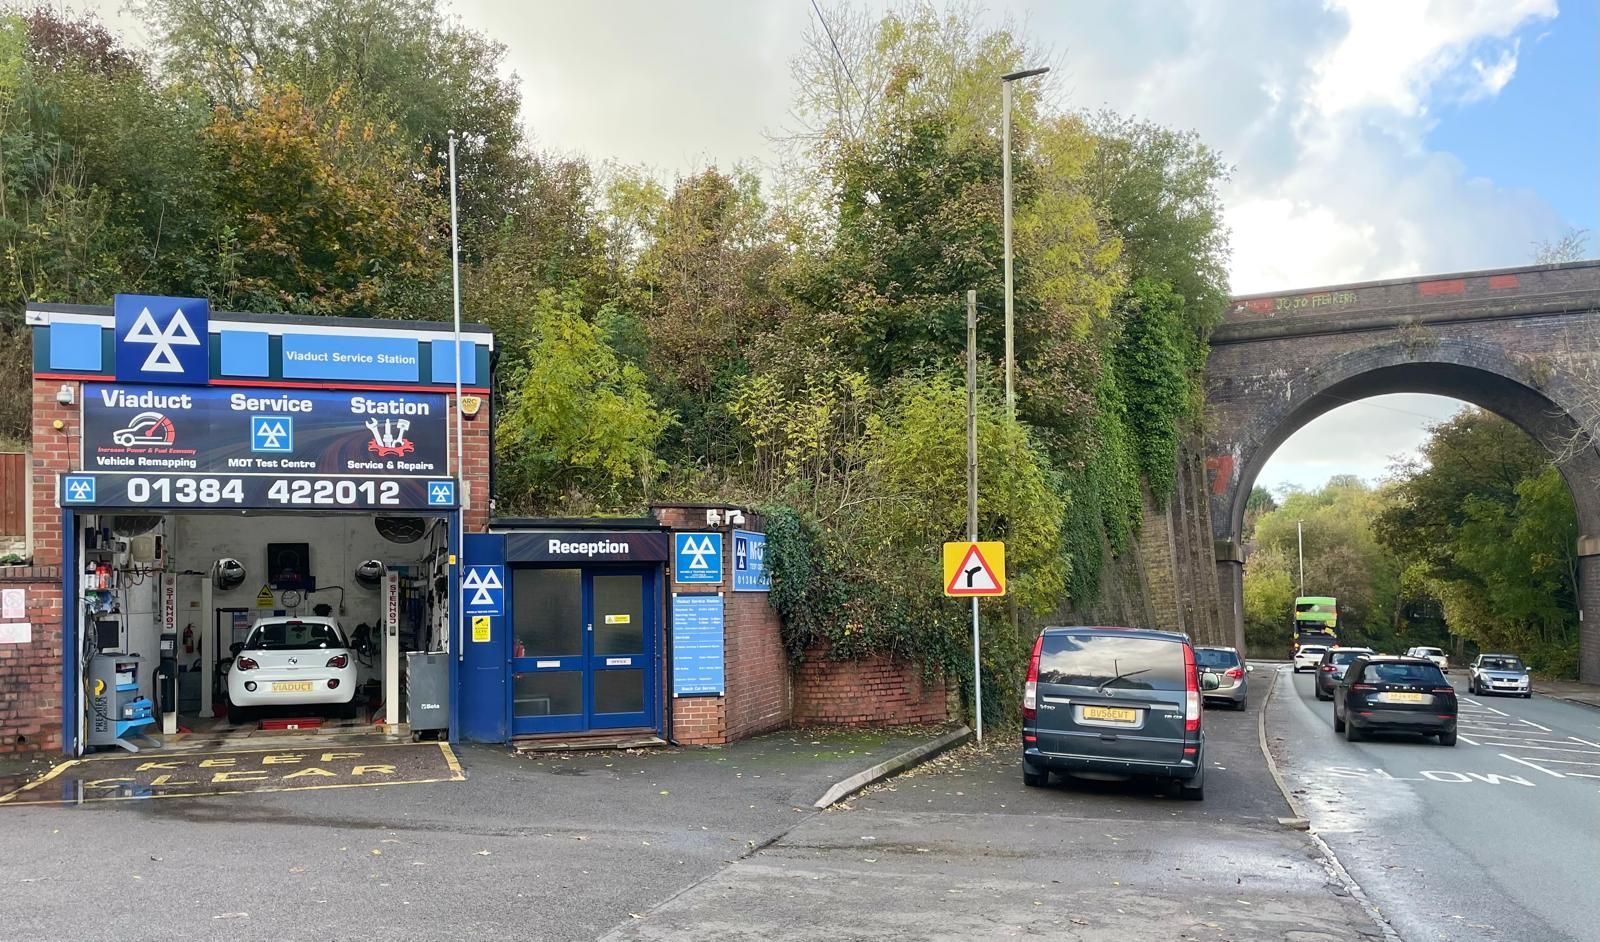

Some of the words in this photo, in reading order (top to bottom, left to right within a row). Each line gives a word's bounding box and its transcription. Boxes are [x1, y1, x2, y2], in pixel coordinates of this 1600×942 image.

[286, 351, 329, 363] Viaduct
[332, 352, 374, 364] Service
[377, 353, 416, 365] Station
[100, 388, 193, 410] Viaduct
[230, 393, 313, 414] Service
[350, 396, 430, 416] Station
[169, 448, 198, 456] Economy
[96, 456, 135, 467] Vehicle
[138, 457, 197, 470] Remapping
[228, 458, 254, 468] MOT
[255, 458, 279, 468] Test
[280, 458, 316, 469] Centre
[347, 460, 384, 470] Service
[386, 460, 395, 470] &
[396, 460, 434, 473] Repairs
[127, 479, 245, 505] 01384
[267, 480, 400, 505] 422012
[548, 539, 629, 558] Reception
[272, 683, 311, 691] VIADUCT
[95, 696, 104, 733] PREMIER
[135, 751, 365, 773] KEEP
[84, 763, 397, 790] CLEAR
[1324, 766, 1537, 787] SLOW
